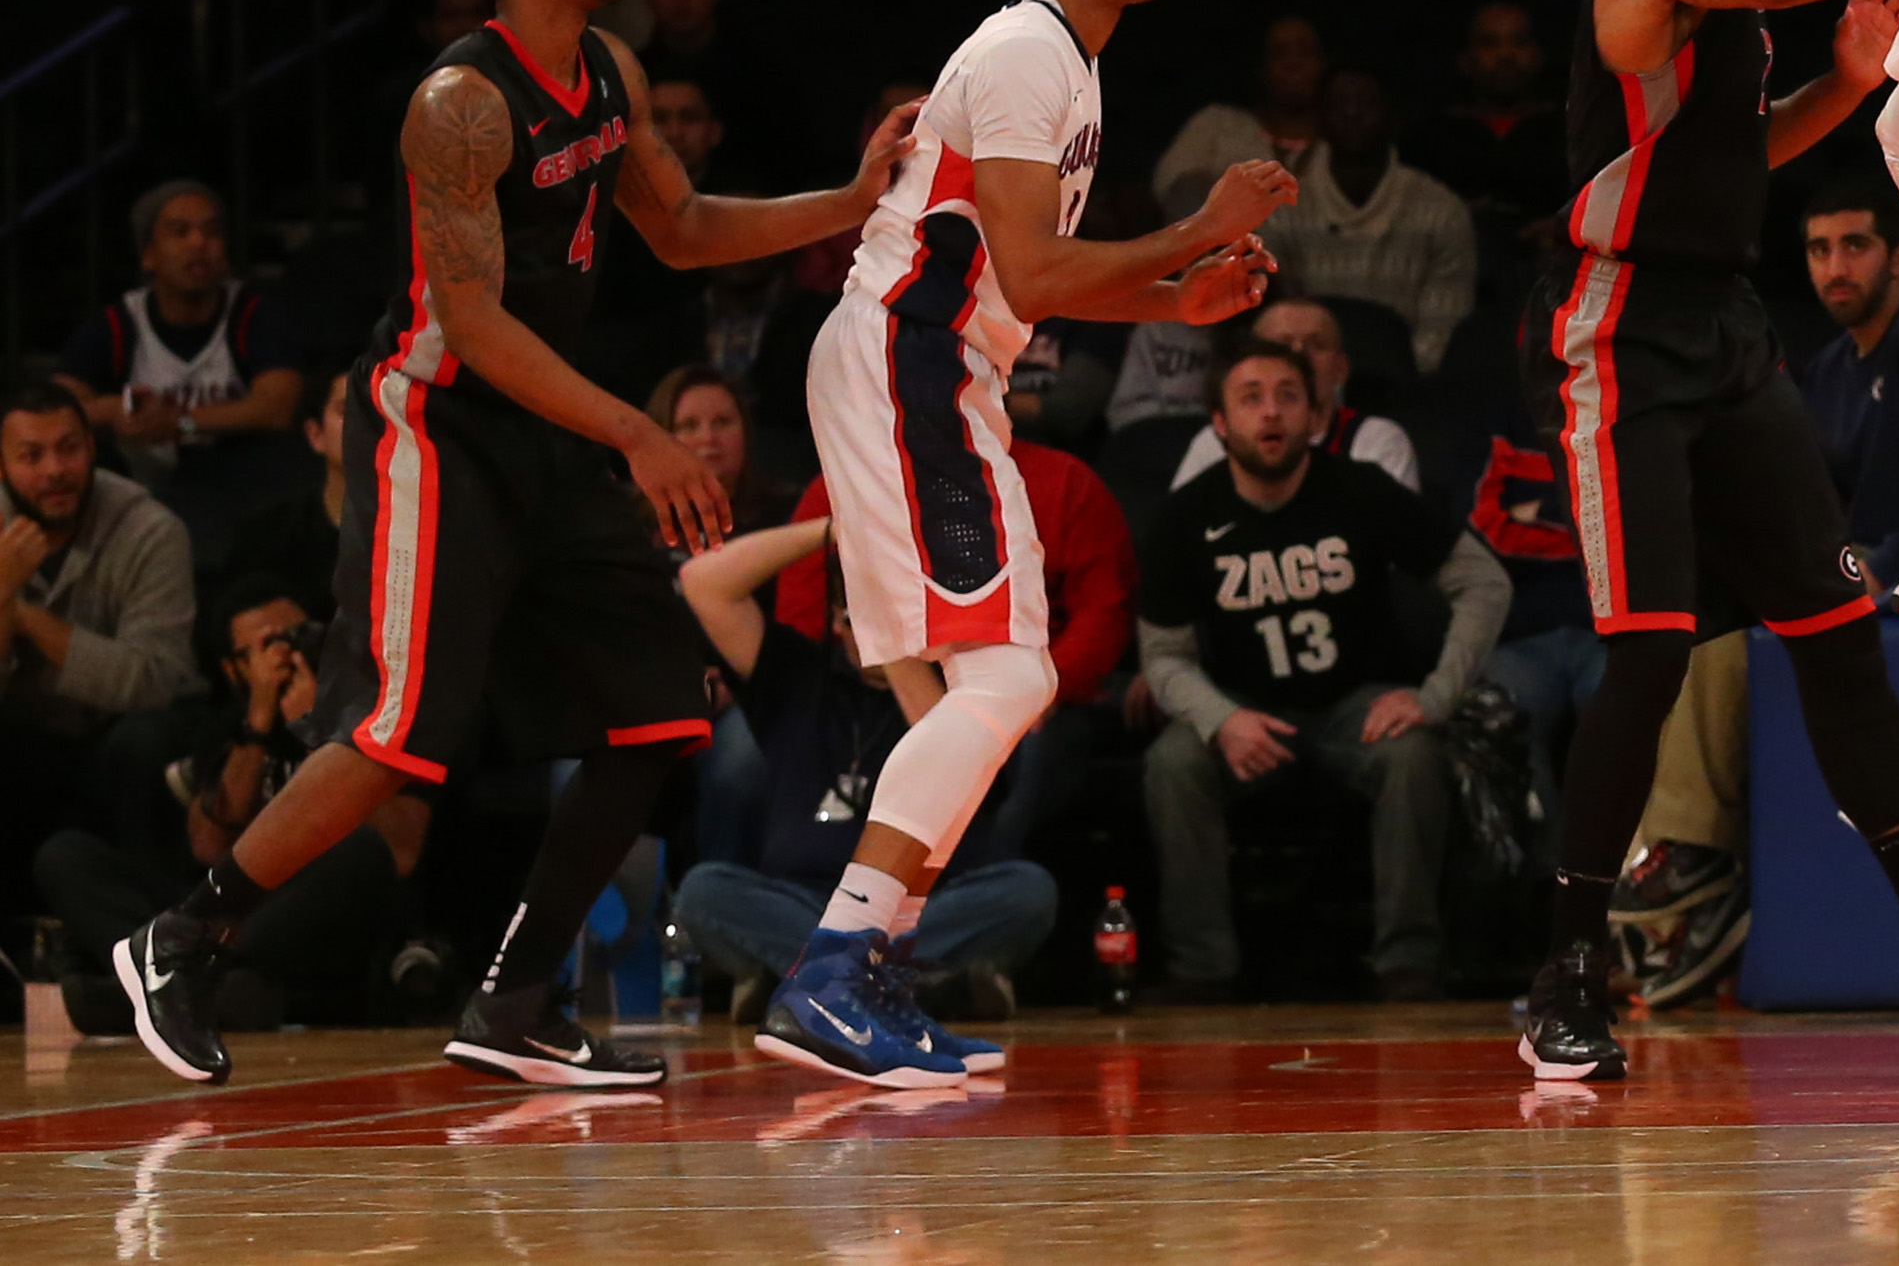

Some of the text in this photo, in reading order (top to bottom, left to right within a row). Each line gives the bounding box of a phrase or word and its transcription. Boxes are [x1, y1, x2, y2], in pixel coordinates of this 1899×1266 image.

[567, 181, 599, 274] 4
[1213, 535, 1357, 612] ZAGS
[1253, 608, 1341, 679] 13
